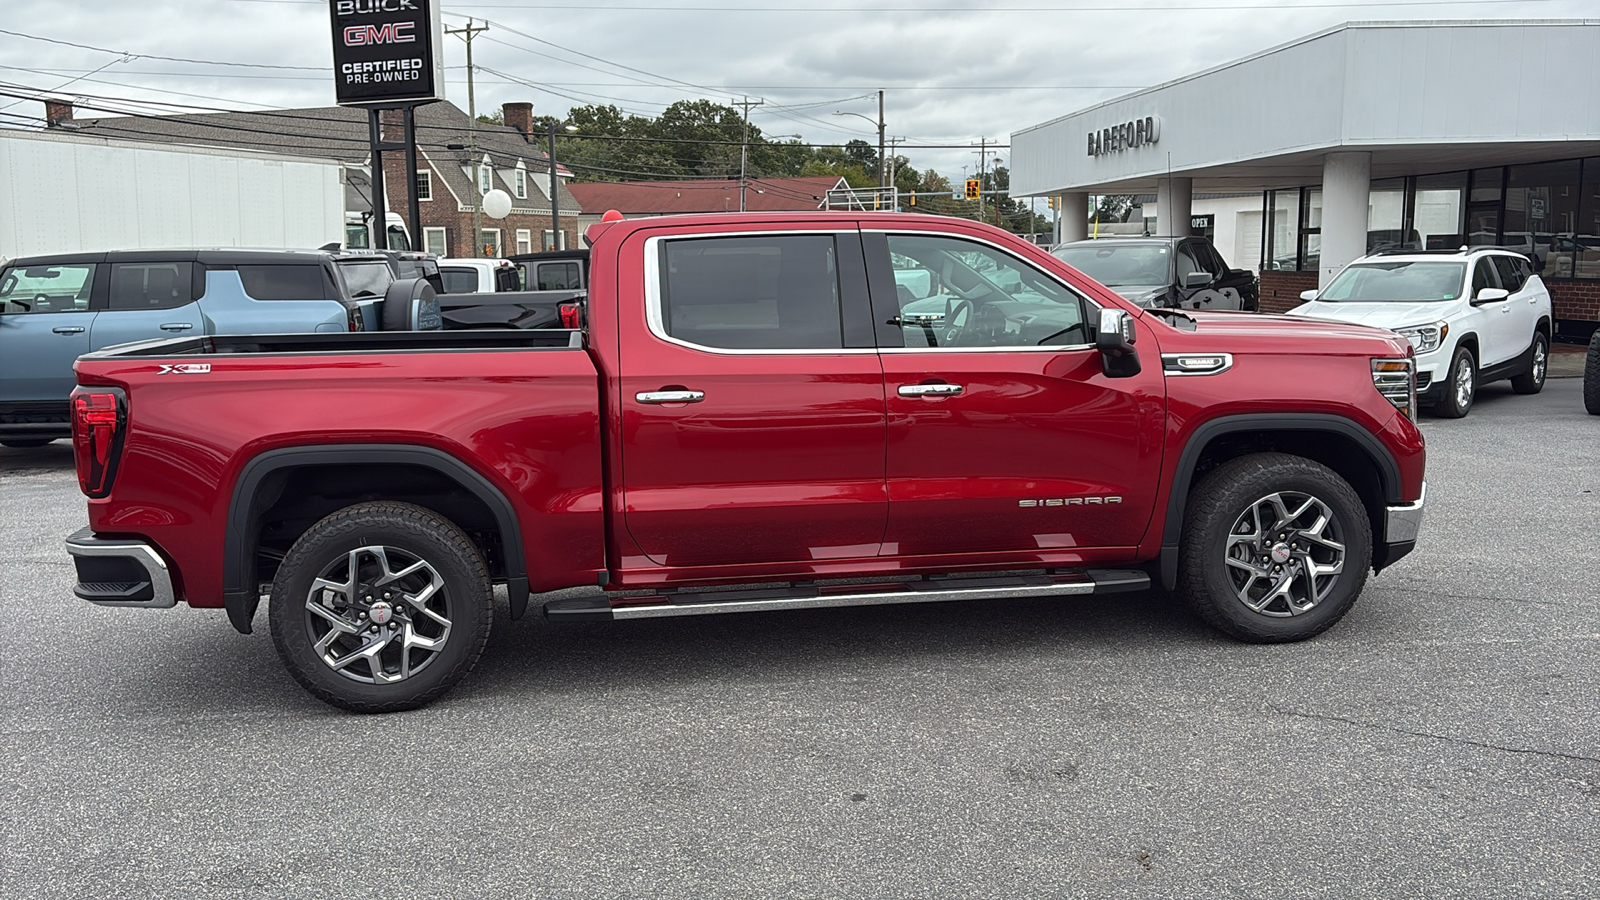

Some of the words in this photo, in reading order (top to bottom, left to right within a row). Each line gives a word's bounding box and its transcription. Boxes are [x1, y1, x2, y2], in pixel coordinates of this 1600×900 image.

[337, 0, 419, 15] BUICK
[344, 22, 415, 46] GMC
[342, 59, 423, 74] CERTIFIED
[347, 70, 419, 84] PRE-OWNED
[1087, 116, 1156, 156] BAREFORD
[1191, 218, 1208, 228] OPEN
[1019, 496, 1122, 507] SIERRA
